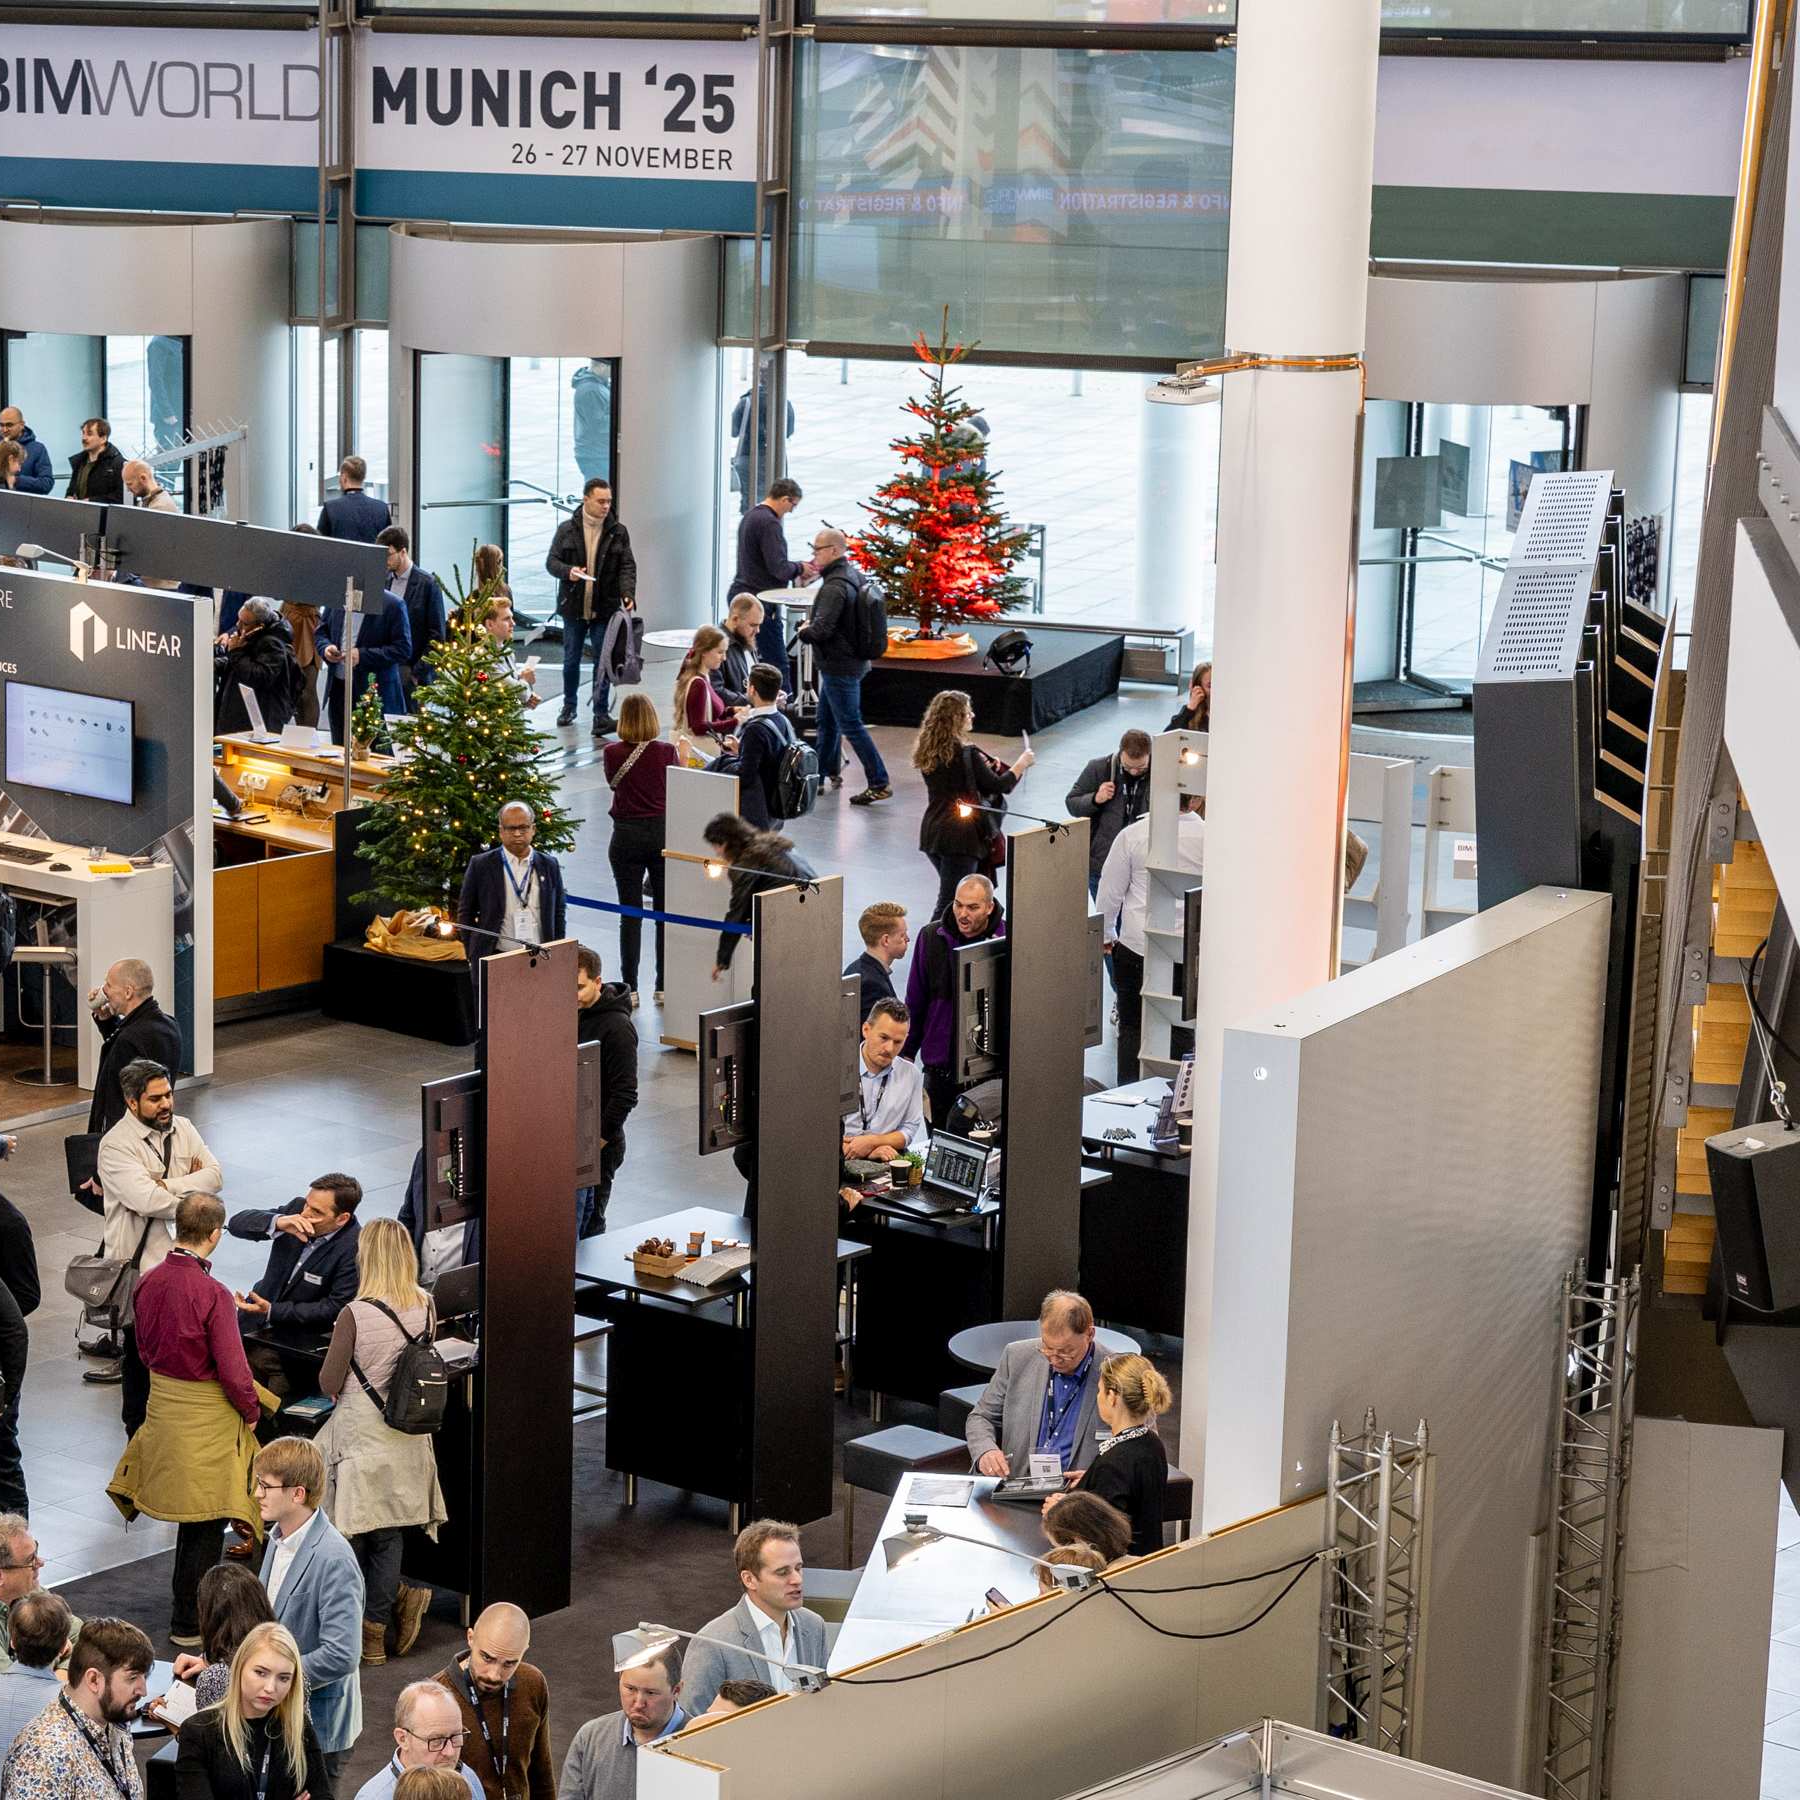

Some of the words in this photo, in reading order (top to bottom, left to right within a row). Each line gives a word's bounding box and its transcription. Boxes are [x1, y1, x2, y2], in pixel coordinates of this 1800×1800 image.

[372, 66, 621, 131] MUNICH
[511, 143, 537, 165] 26
[562, 145, 587, 166] 27
[597, 146, 733, 171] NOVEMBER
[116, 627, 182, 659] LINEAR
